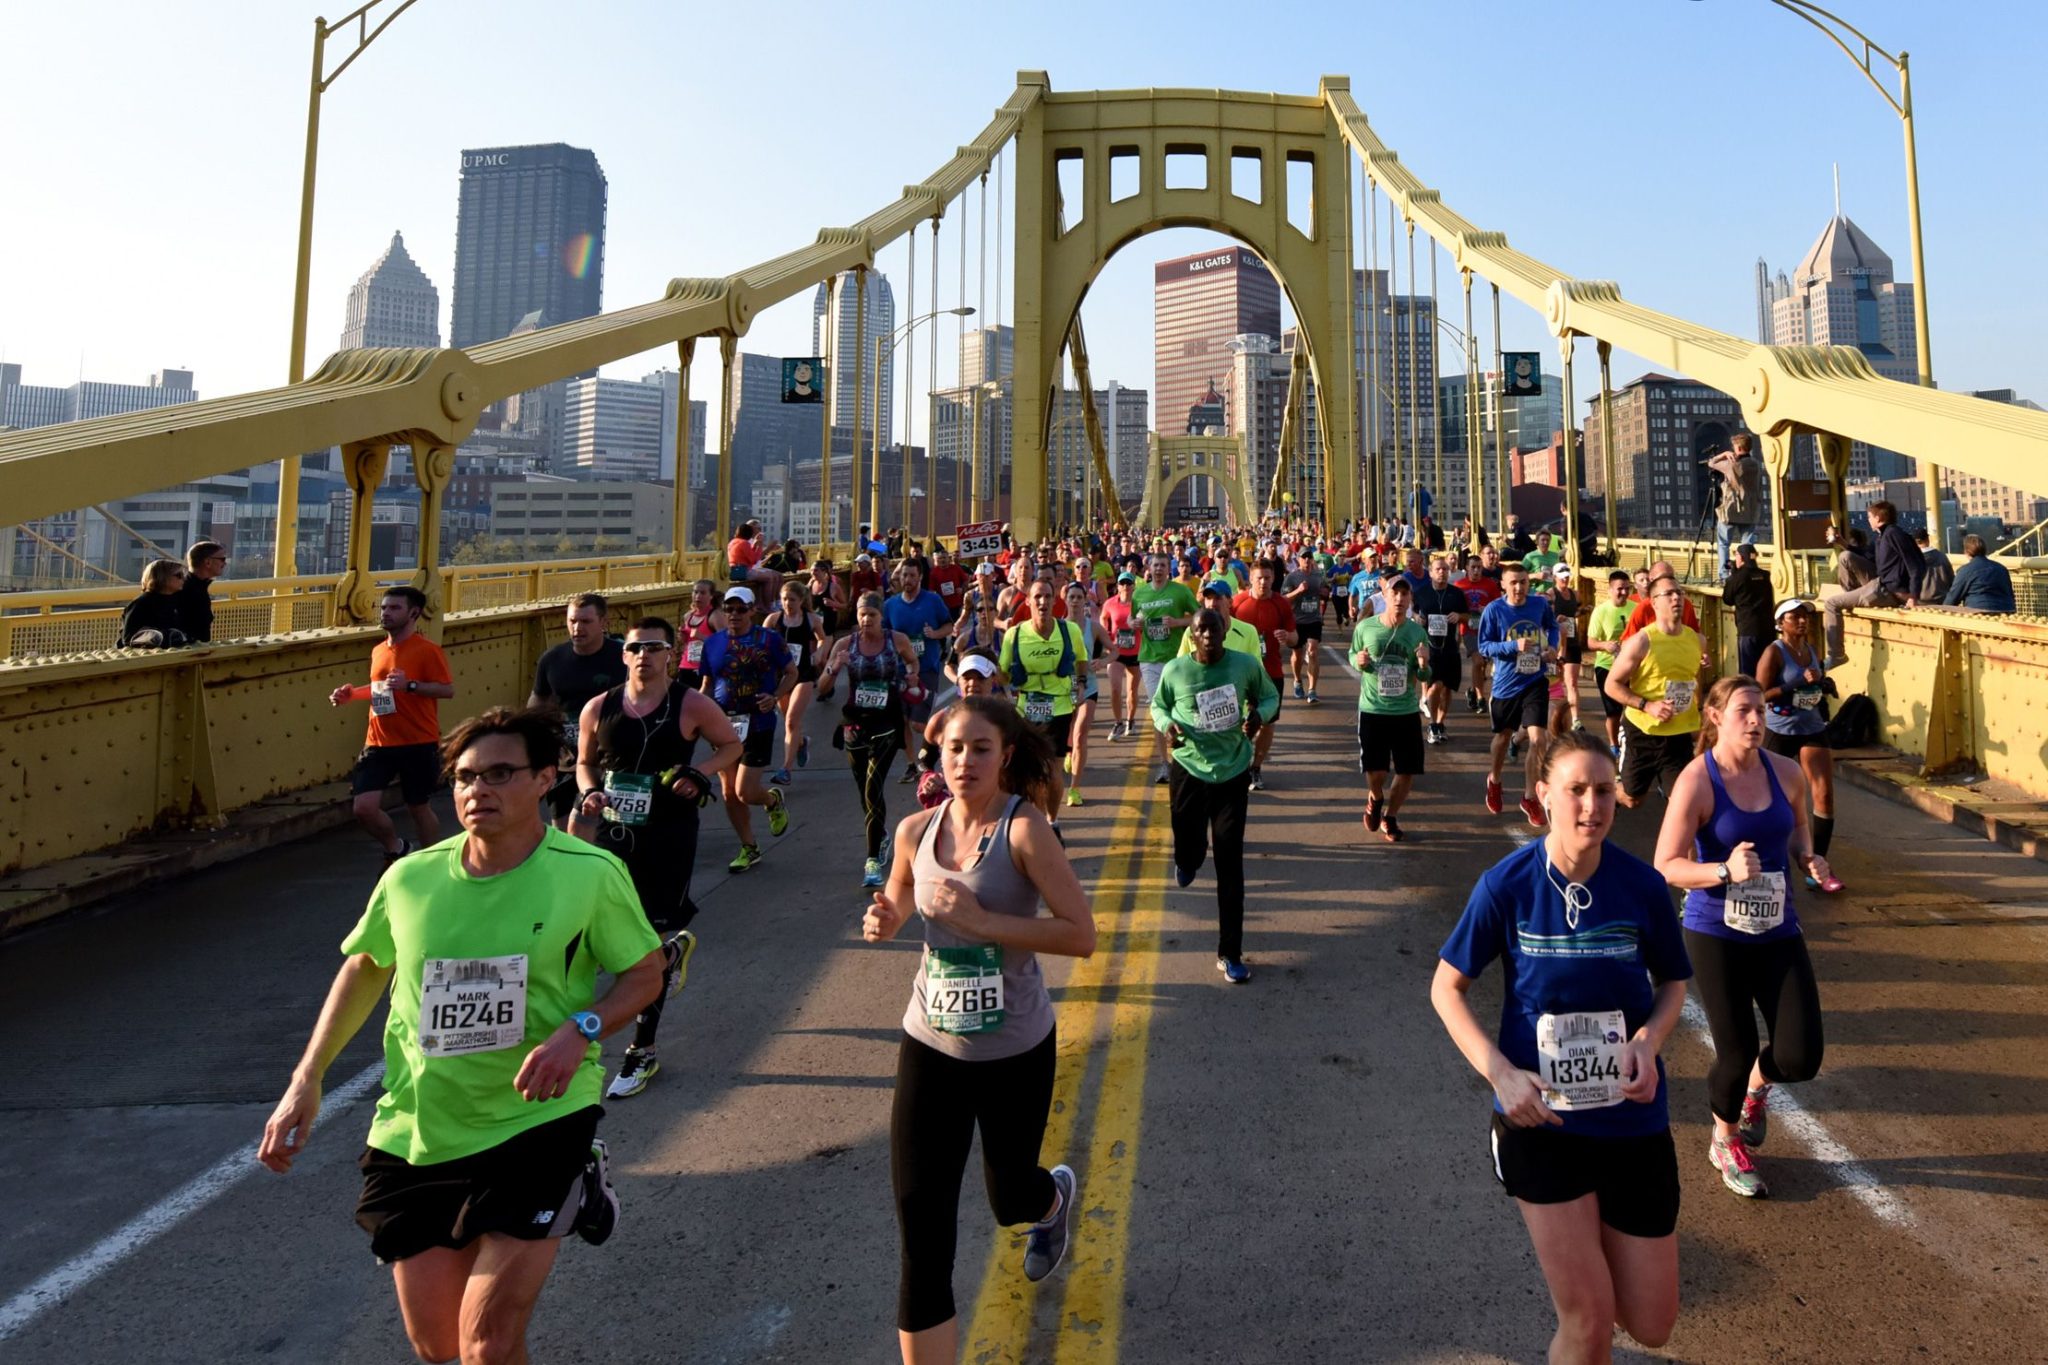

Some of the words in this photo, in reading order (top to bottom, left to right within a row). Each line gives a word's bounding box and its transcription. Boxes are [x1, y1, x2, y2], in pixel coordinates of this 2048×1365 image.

[462, 153, 509, 168] UPMC
[1190, 260, 1204, 272] K&L
[1205, 254, 1232, 268] GATES
[962, 536, 999, 553] 3:45
[1026, 705, 1052, 715] 5205
[1204, 703, 1236, 721] 15906
[1733, 899, 1780, 918] 10300
[941, 979, 982, 989] DANIELLE
[456, 991, 491, 1002] MARK
[931, 987, 997, 1013] 4266
[431, 1000, 514, 1030] 16246
[444, 1029, 491, 1040] PITTSBURGH
[444, 1037, 491, 1047] MARATHON
[1568, 1047, 1598, 1058] DIANE
[1550, 1056, 1620, 1084] 13344
